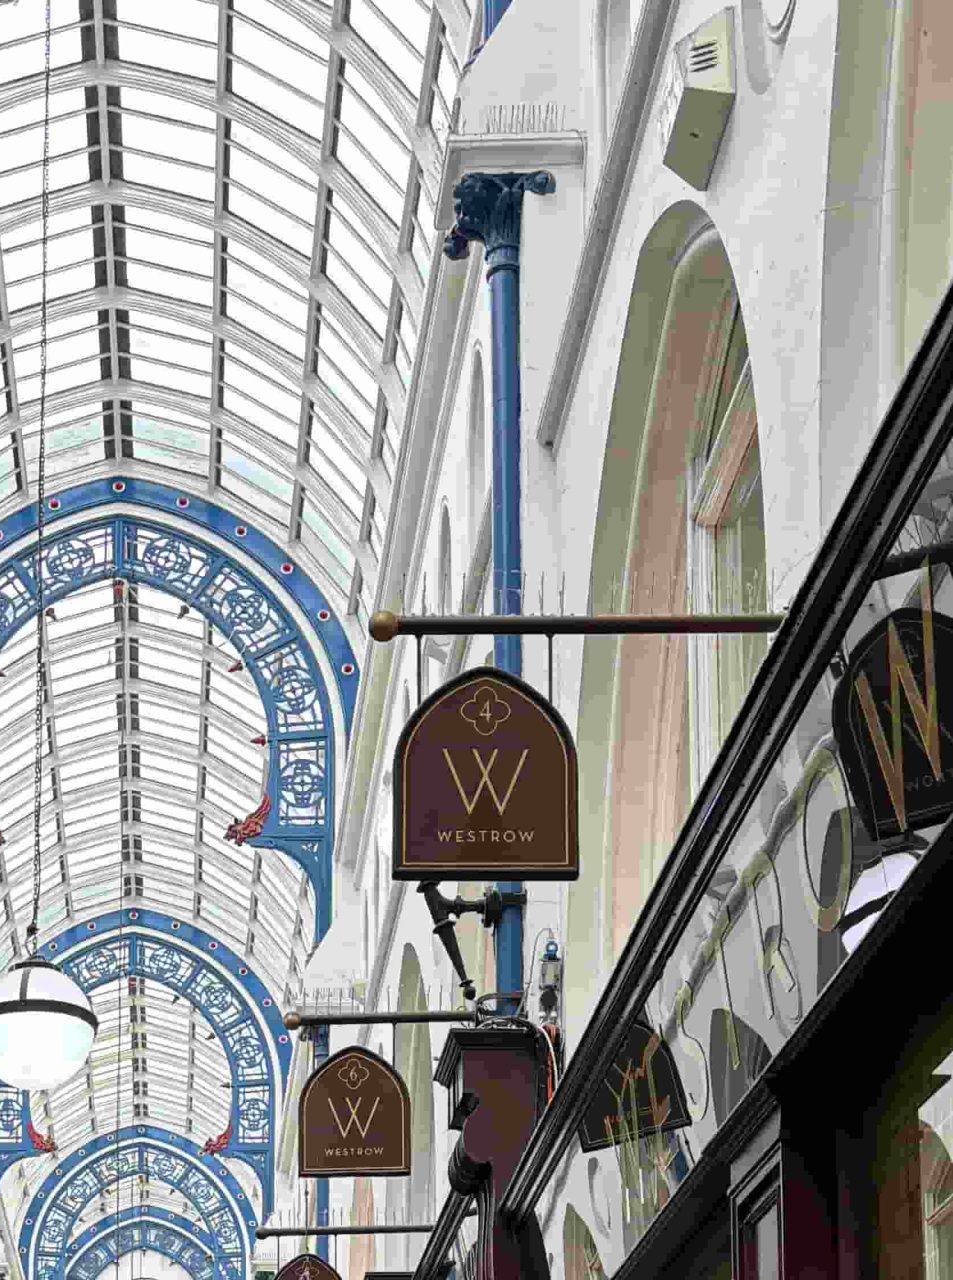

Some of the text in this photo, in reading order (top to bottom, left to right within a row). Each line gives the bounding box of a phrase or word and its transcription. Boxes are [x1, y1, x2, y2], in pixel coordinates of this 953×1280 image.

[479, 700, 492, 723] 4
[442, 748, 529, 816] W
[437, 829, 535, 843] WESTROW
[350, 1068, 357, 1081] 6
[328, 1096, 380, 1139] W
[324, 1146, 384, 1157] WESTROW
